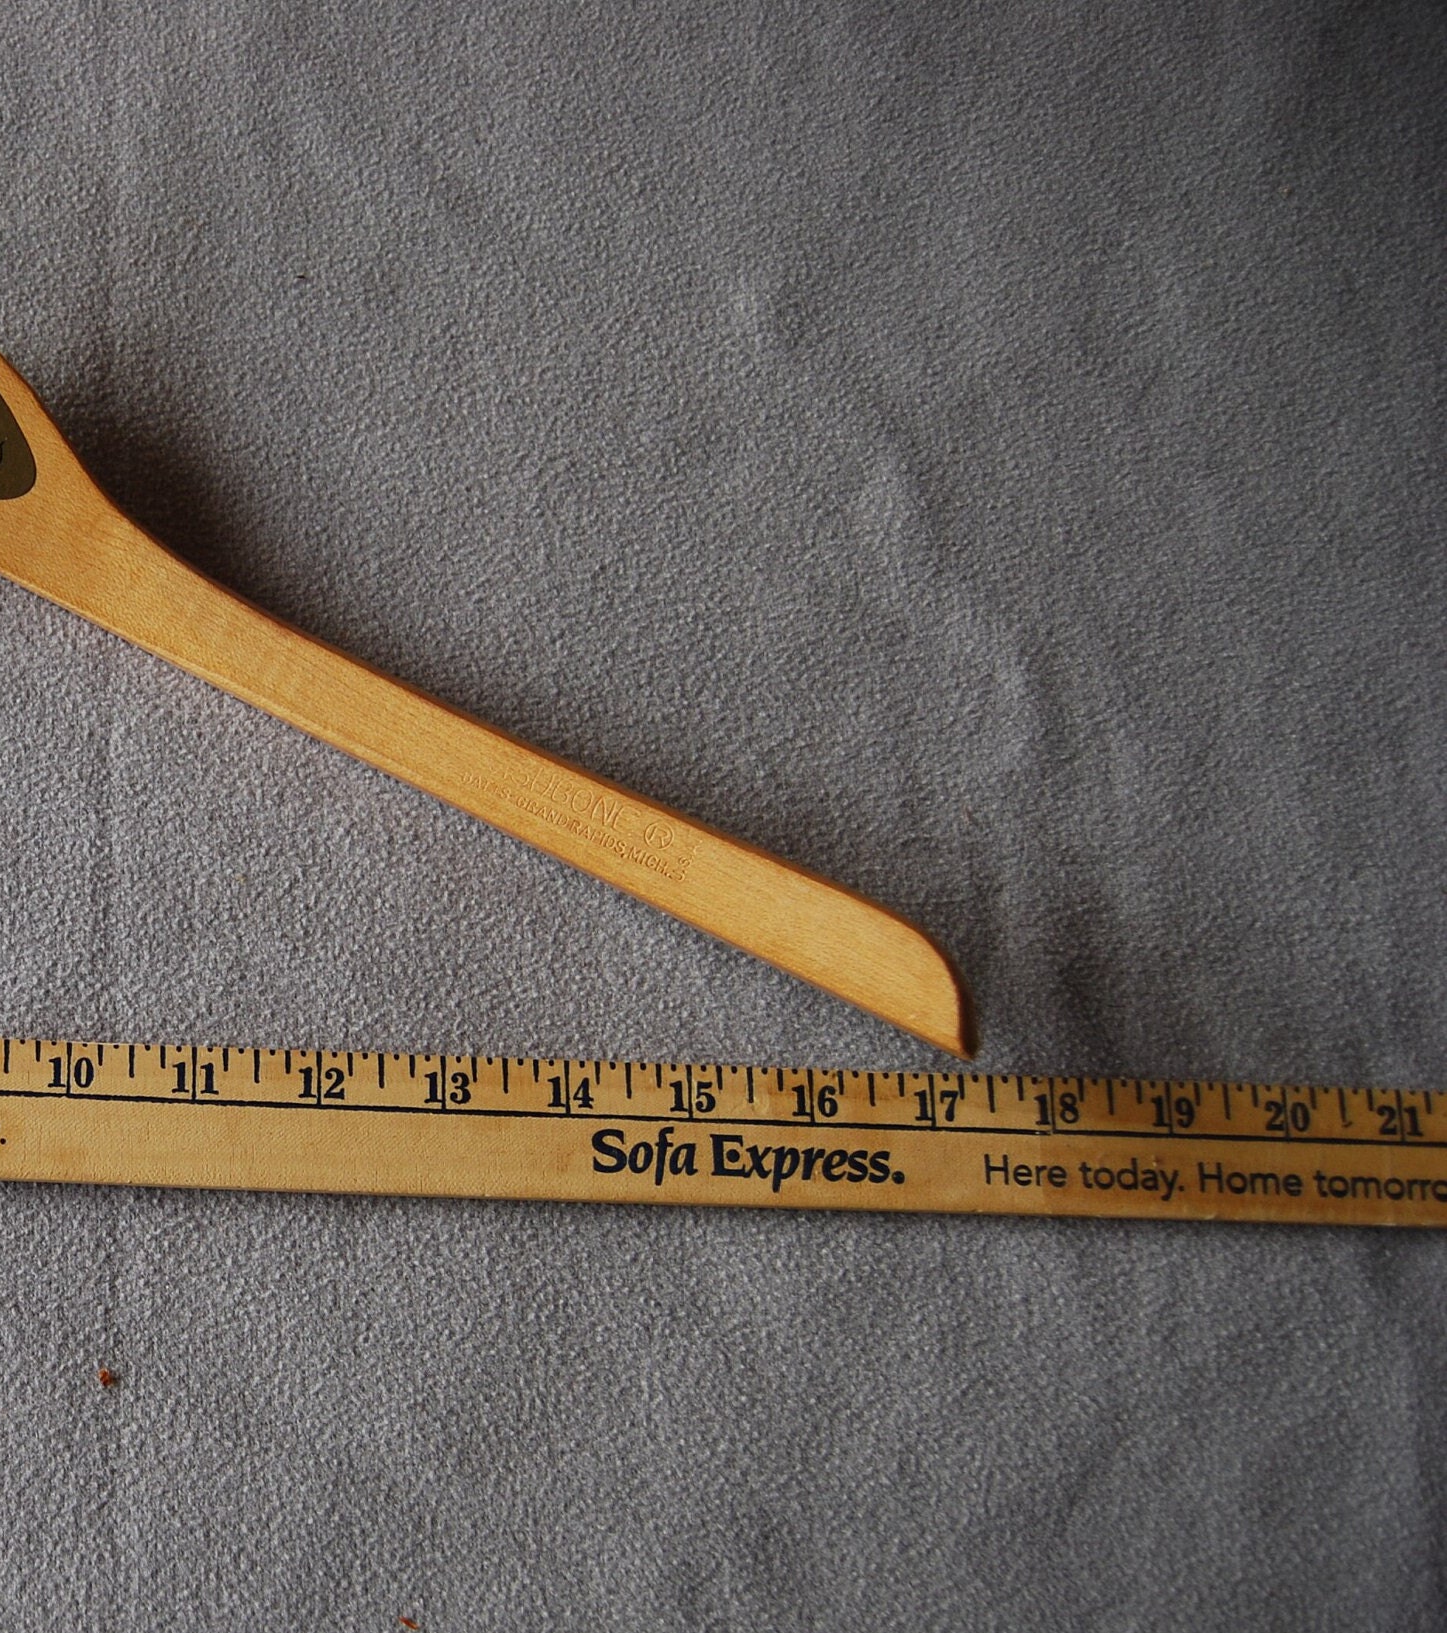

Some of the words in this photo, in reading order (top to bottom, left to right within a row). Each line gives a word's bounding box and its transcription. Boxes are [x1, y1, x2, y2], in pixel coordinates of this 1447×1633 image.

[515, 795, 571, 829] GRAND
[47, 1057, 94, 1088] 10
[171, 1062, 219, 1095] 11
[298, 1067, 345, 1099] 12
[424, 1072, 471, 1104] 13
[547, 1076, 594, 1109] 14
[669, 1081, 716, 1113] 15
[792, 1085, 838, 1118] 16
[914, 1090, 959, 1122] 17
[1034, 1093, 1080, 1125] 18
[1152, 1095, 1196, 1128] 19
[1265, 1101, 1311, 1132] 20
[1377, 1105, 1424, 1137] 21
[591, 1126, 698, 1187] Sofa
[710, 1133, 906, 1194] Express.
[984, 1153, 1068, 1188] Here
[1078, 1157, 1186, 1201] today.
[1198, 1161, 1303, 1197] Home
